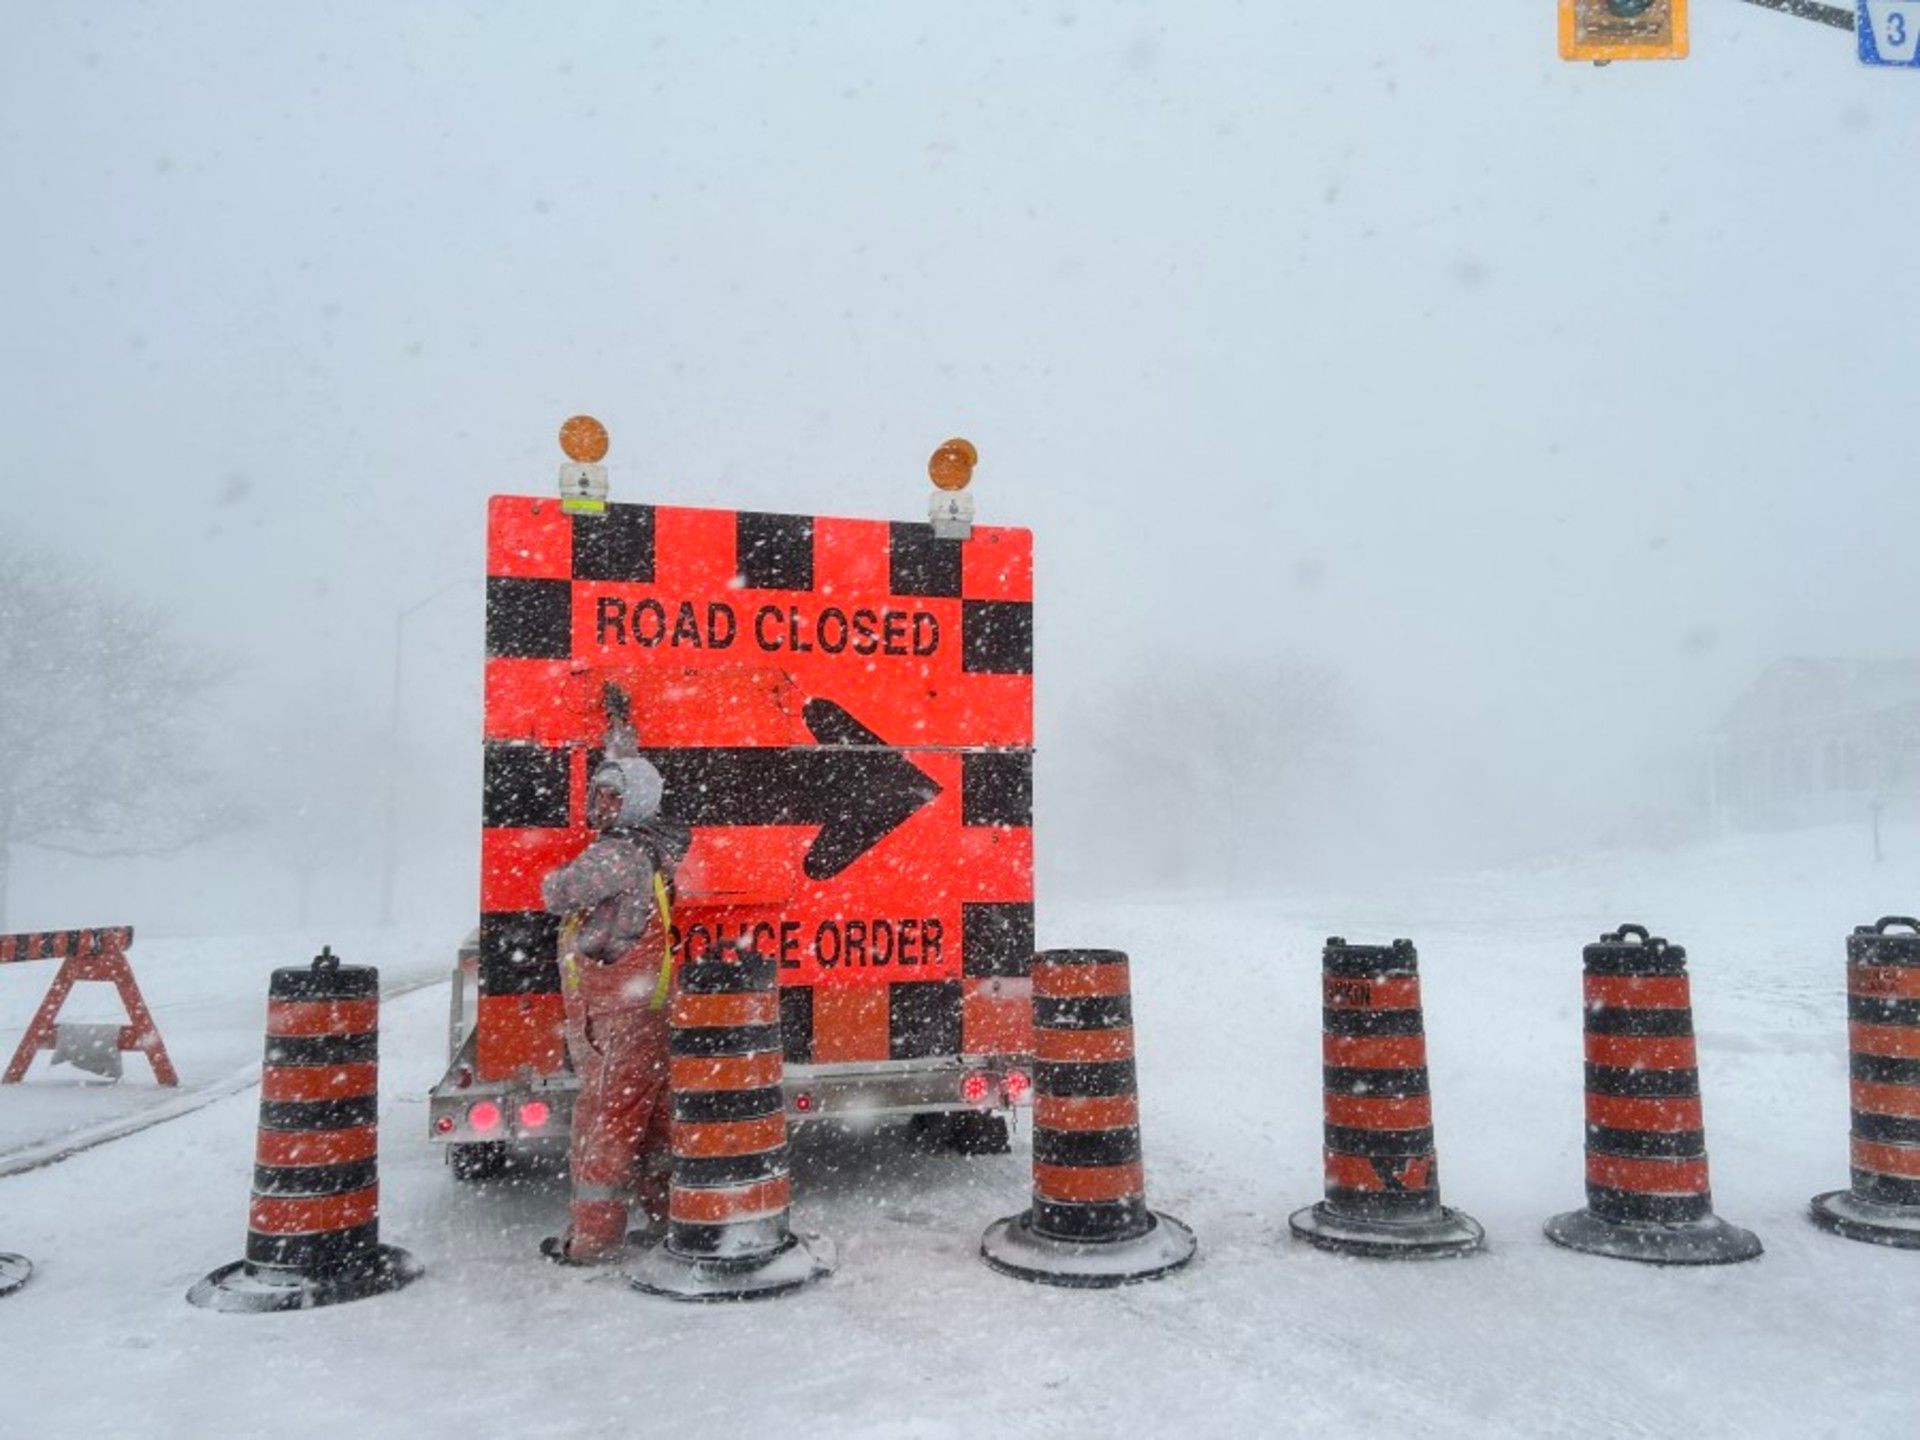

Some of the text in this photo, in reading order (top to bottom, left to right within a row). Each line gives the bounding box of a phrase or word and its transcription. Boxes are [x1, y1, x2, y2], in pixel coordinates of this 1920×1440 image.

[1887, 12, 1906, 46] 3
[596, 596, 941, 656] ROAD CLOSED
[814, 918, 944, 968] ORDER
